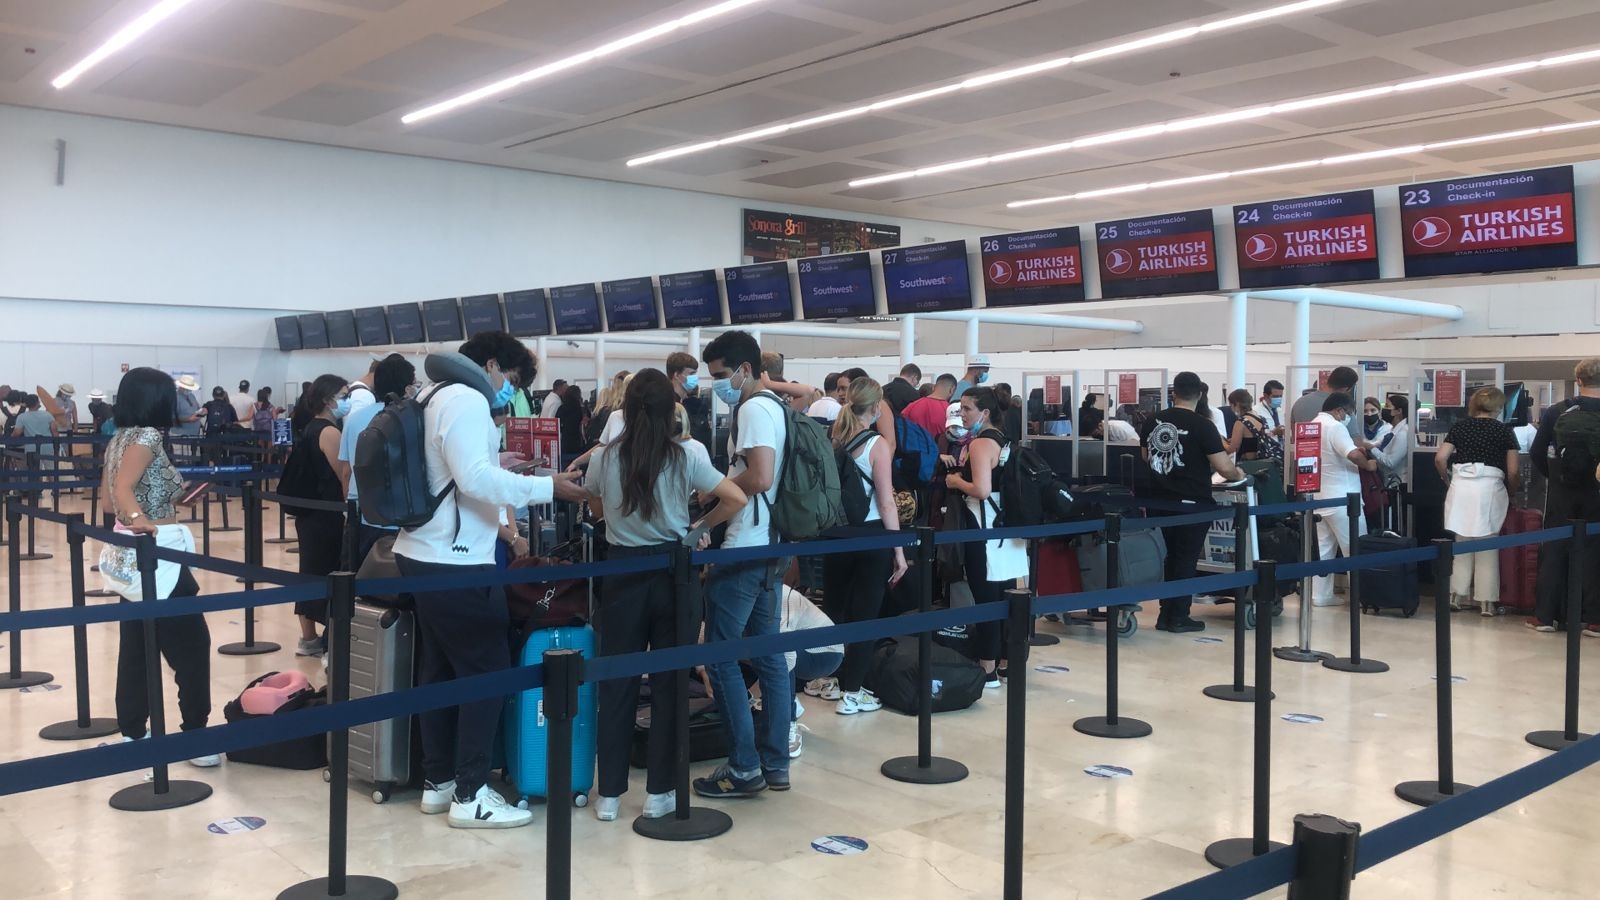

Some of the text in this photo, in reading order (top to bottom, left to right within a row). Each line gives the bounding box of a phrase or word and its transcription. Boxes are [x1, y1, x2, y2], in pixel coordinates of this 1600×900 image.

[1446, 174, 1535, 192] Documentación
[1403, 189, 1432, 206] 23
[1447, 190, 1496, 202] Check-in
[1272, 197, 1343, 212] Documentación
[1127, 215, 1187, 229] Documentación
[1238, 208, 1261, 224] 24
[1273, 211, 1313, 221] Check-in
[1459, 204, 1562, 228] TURKISH
[747, 214, 807, 237] Sonora grill
[1129, 228, 1162, 237] Check-in
[1460, 221, 1566, 244] AIRLINES
[1007, 232, 1058, 243] Documentación
[1099, 226, 1118, 240] 25
[1283, 225, 1366, 244] TURKISH
[983, 239, 1000, 252] 26
[1138, 240, 1207, 259] TURKISH
[1284, 239, 1369, 258] AIRLINES
[884, 252, 898, 265] 27
[1015, 255, 1075, 271] TURKISH
[1138, 253, 1209, 272] AIRLINES
[799, 263, 812, 273] 28
[1016, 267, 1077, 282] AIRLINES
[726, 271, 737, 280] 29
[899, 276, 946, 289] Southwest
[660, 278, 671, 288] 30
[813, 284, 854, 296] Southwest
[672, 297, 704, 308] Southwest
[738, 291, 774, 302] Southwest
